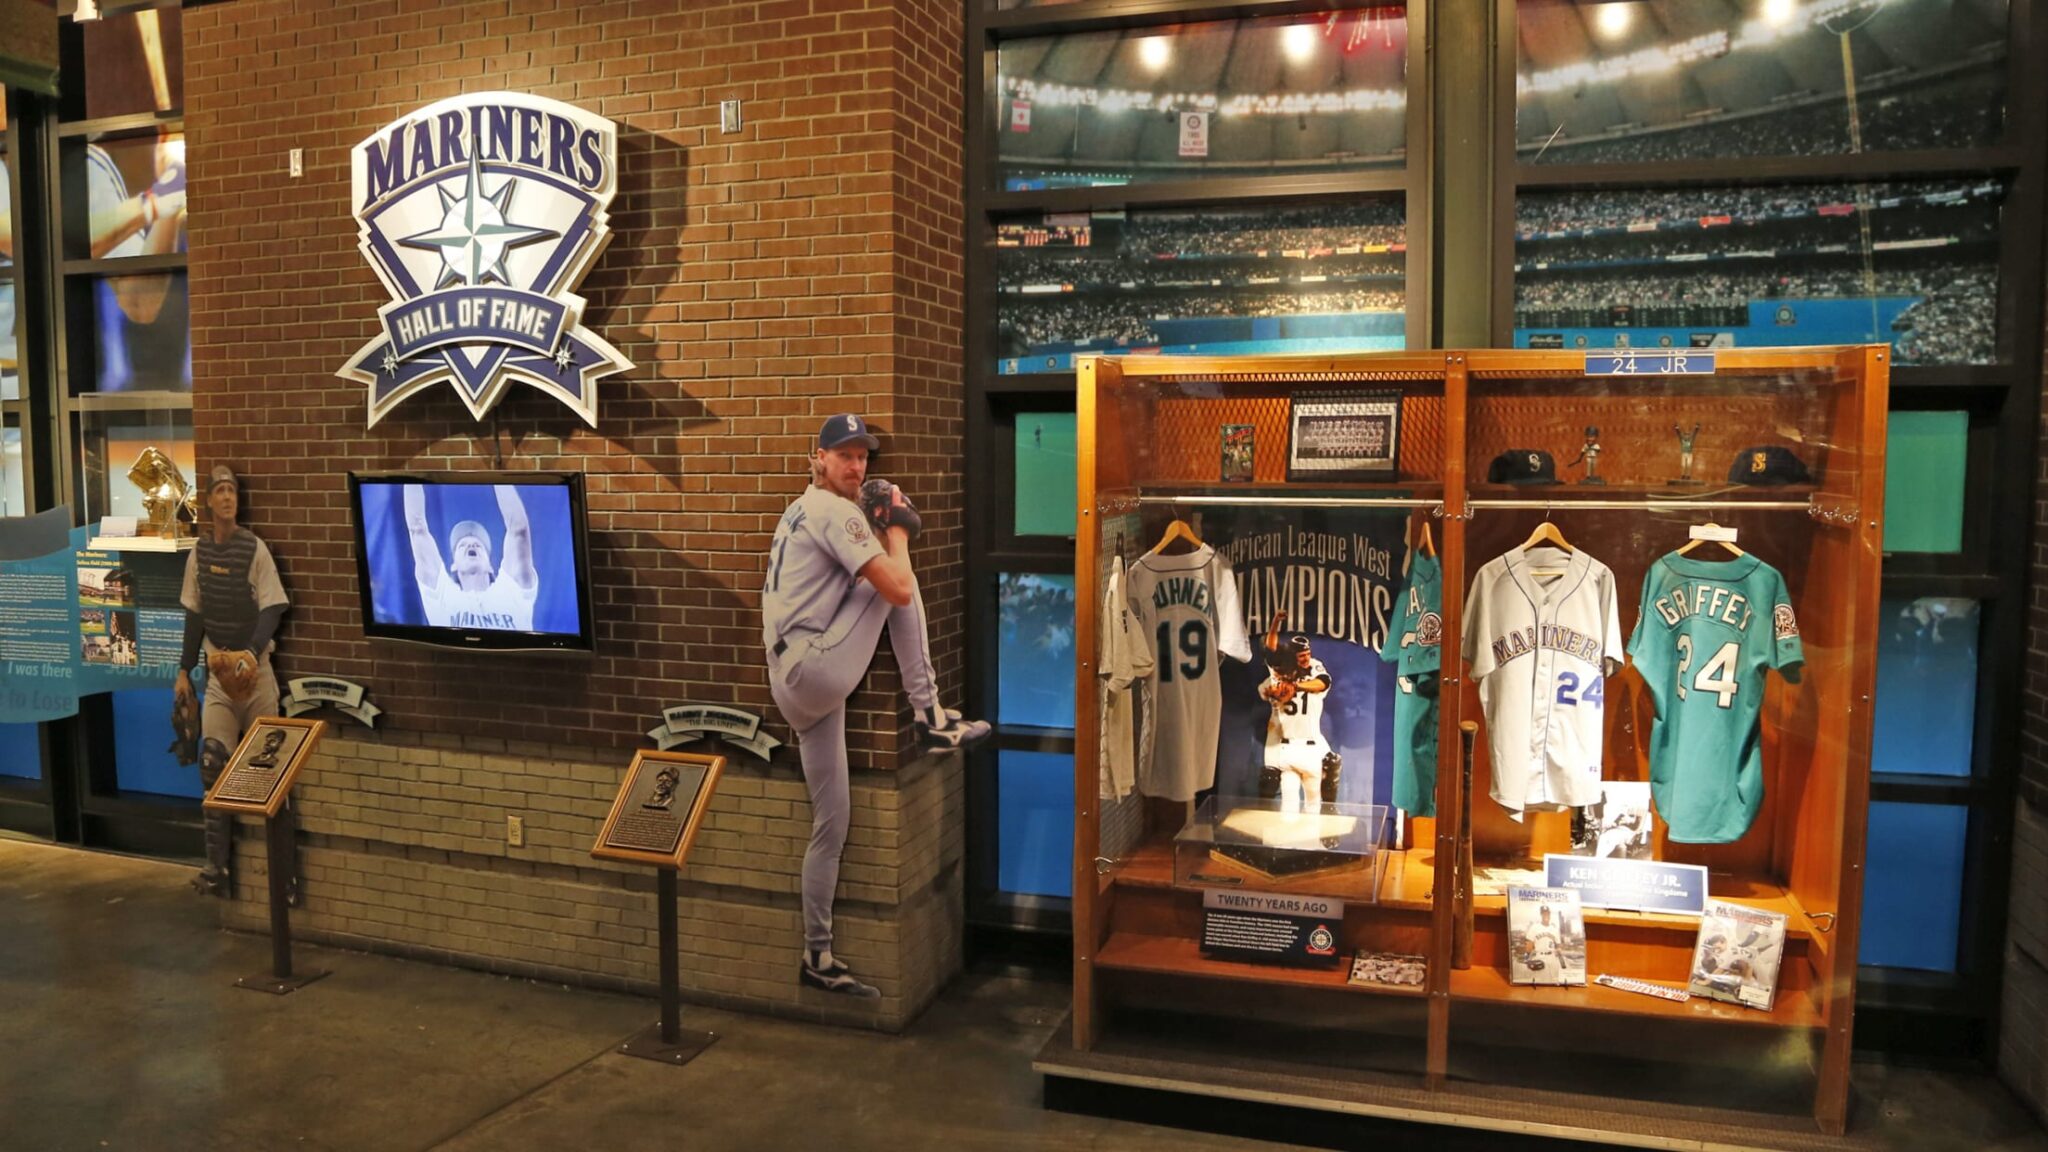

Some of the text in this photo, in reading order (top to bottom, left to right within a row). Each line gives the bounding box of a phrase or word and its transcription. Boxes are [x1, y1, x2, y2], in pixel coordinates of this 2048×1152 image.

[361, 105, 602, 212] MARINERS
[396, 299, 551, 345] HALL OF FAME
[1612, 357, 1688, 374] 24 JR
[846, 415, 858, 432] S
[1751, 452, 1767, 473] S
[1213, 524, 1392, 581] merican League West
[1152, 576, 1212, 616] UHNE
[1236, 564, 1392, 655] AMPIONS
[1655, 583, 1752, 632] GRIFFEY
[1156, 618, 1208, 684] 19
[1491, 622, 1604, 673] MARINER
[15, 665, 39, 677] was
[42, 662, 73, 679] there
[1556, 670, 1604, 710] 24
[1676, 632, 1741, 710] 24
[1283, 691, 1308, 716] 51
[1569, 867, 1681, 887] KEN GFEY JR.
[1217, 894, 1328, 914] TWENTY YEARS AGO
